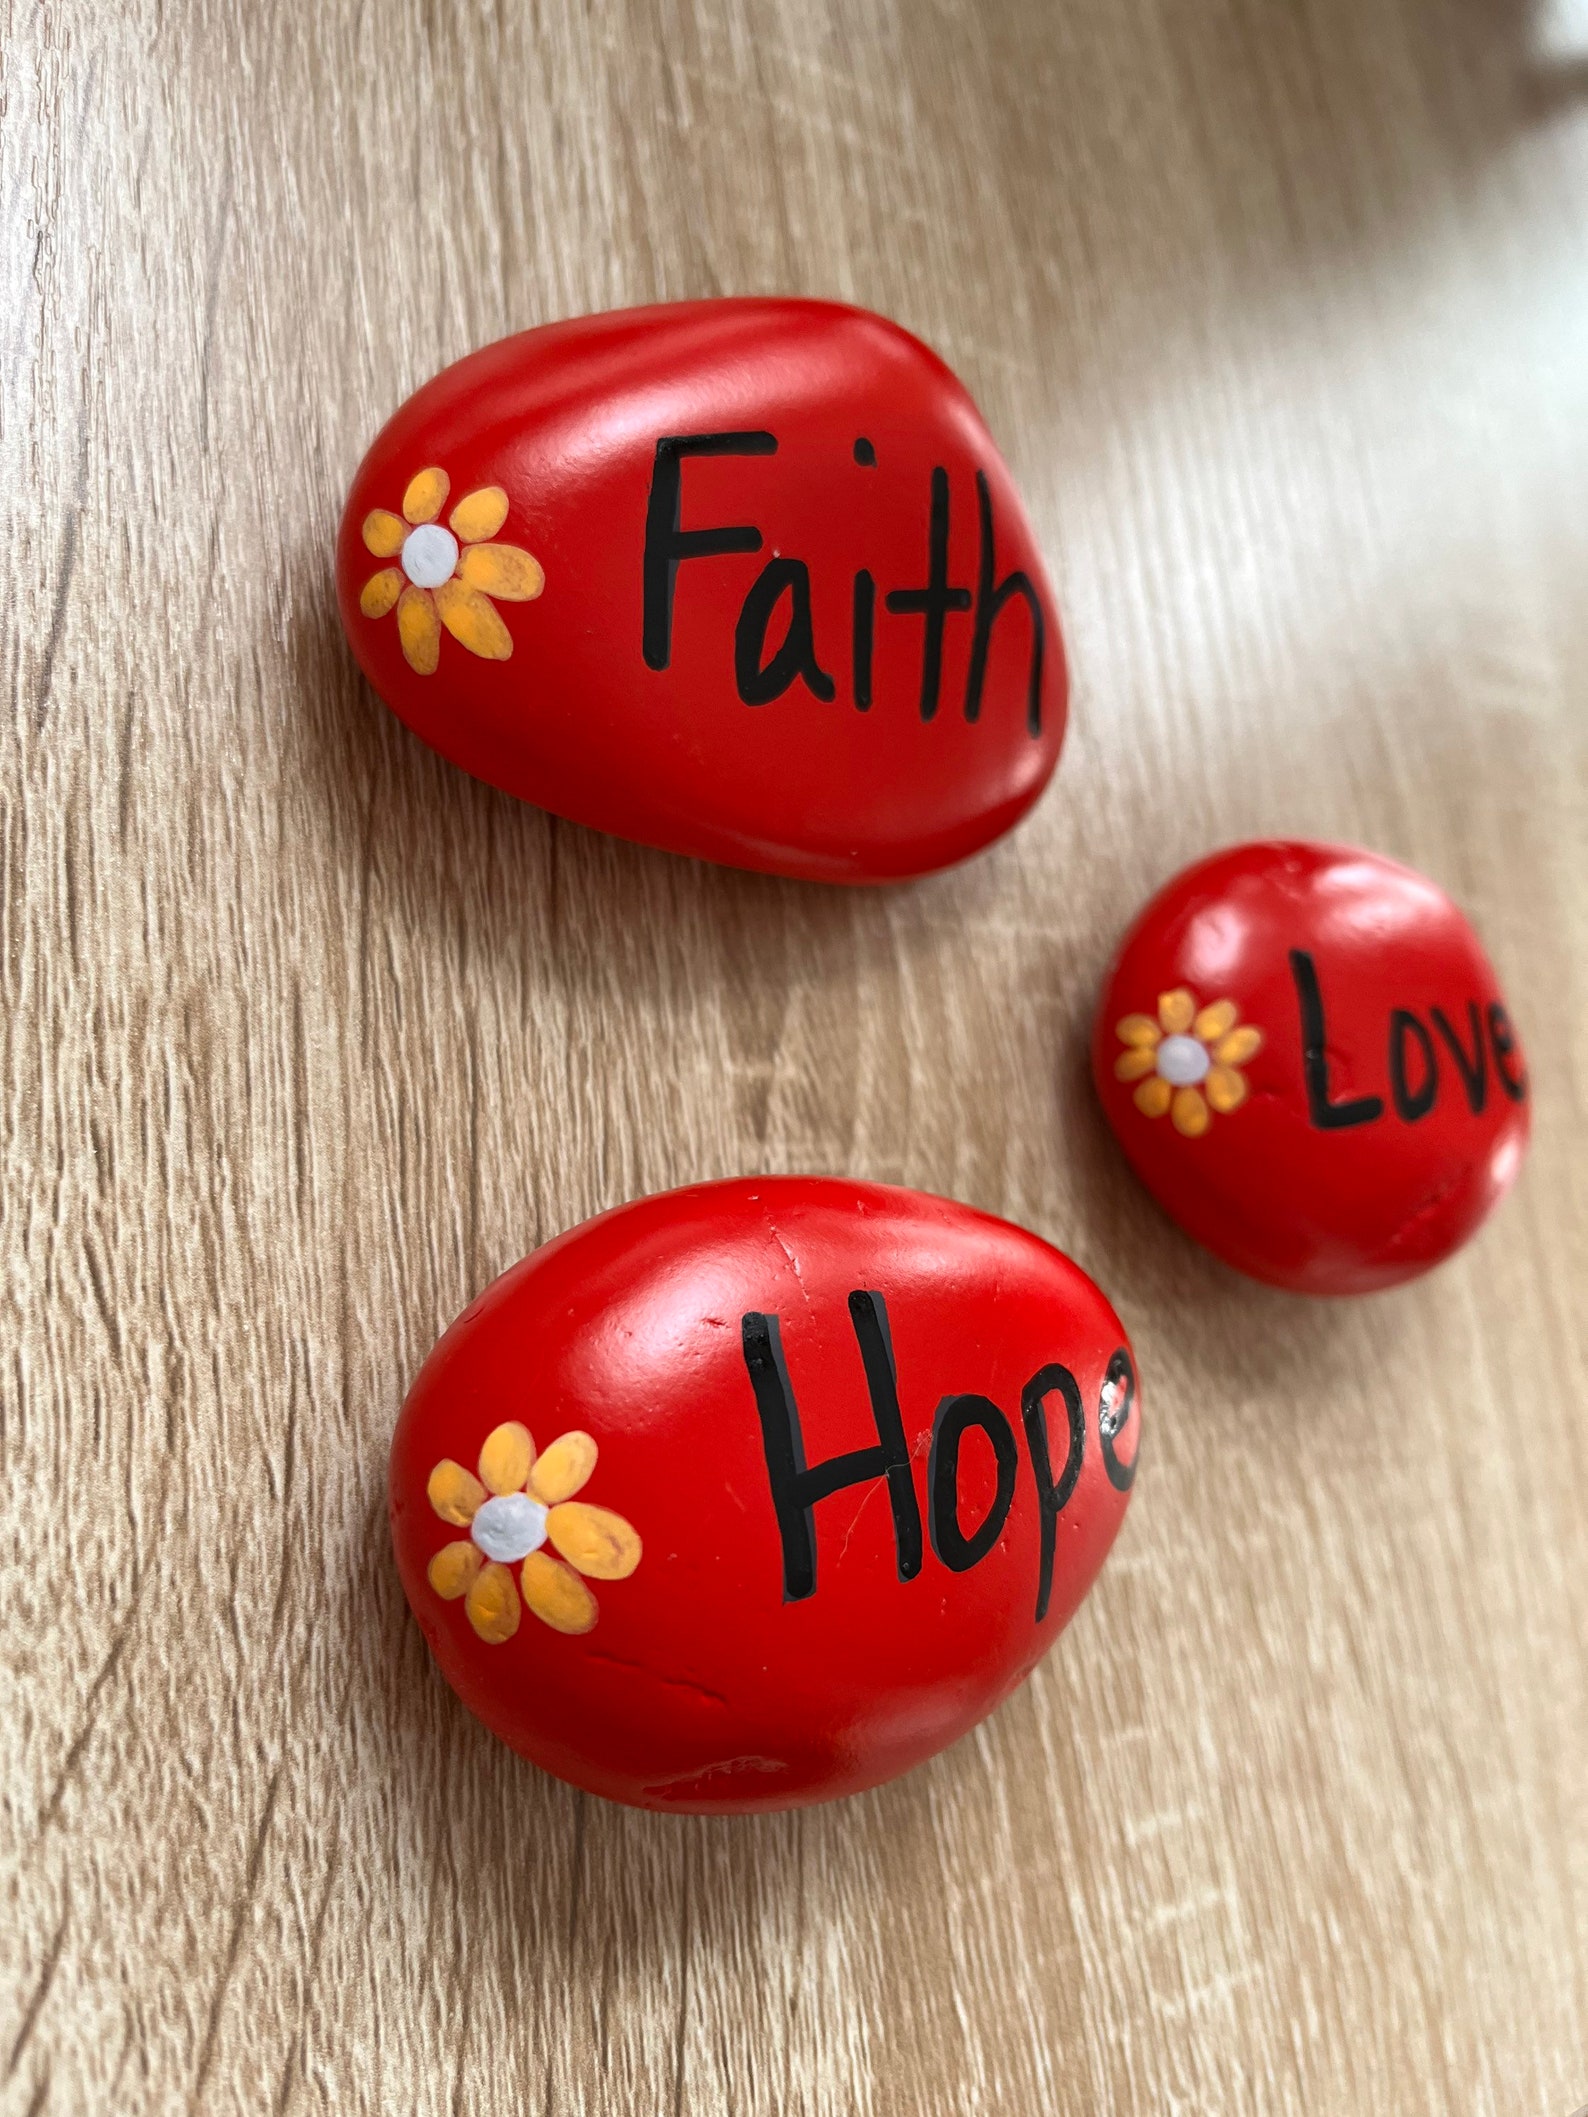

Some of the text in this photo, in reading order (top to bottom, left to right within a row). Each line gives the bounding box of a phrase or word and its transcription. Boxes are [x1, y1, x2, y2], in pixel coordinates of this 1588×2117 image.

[642, 430, 1045, 738] Faith
[1289, 949, 1527, 1130] Love
[741, 1289, 1141, 1623] Hope
